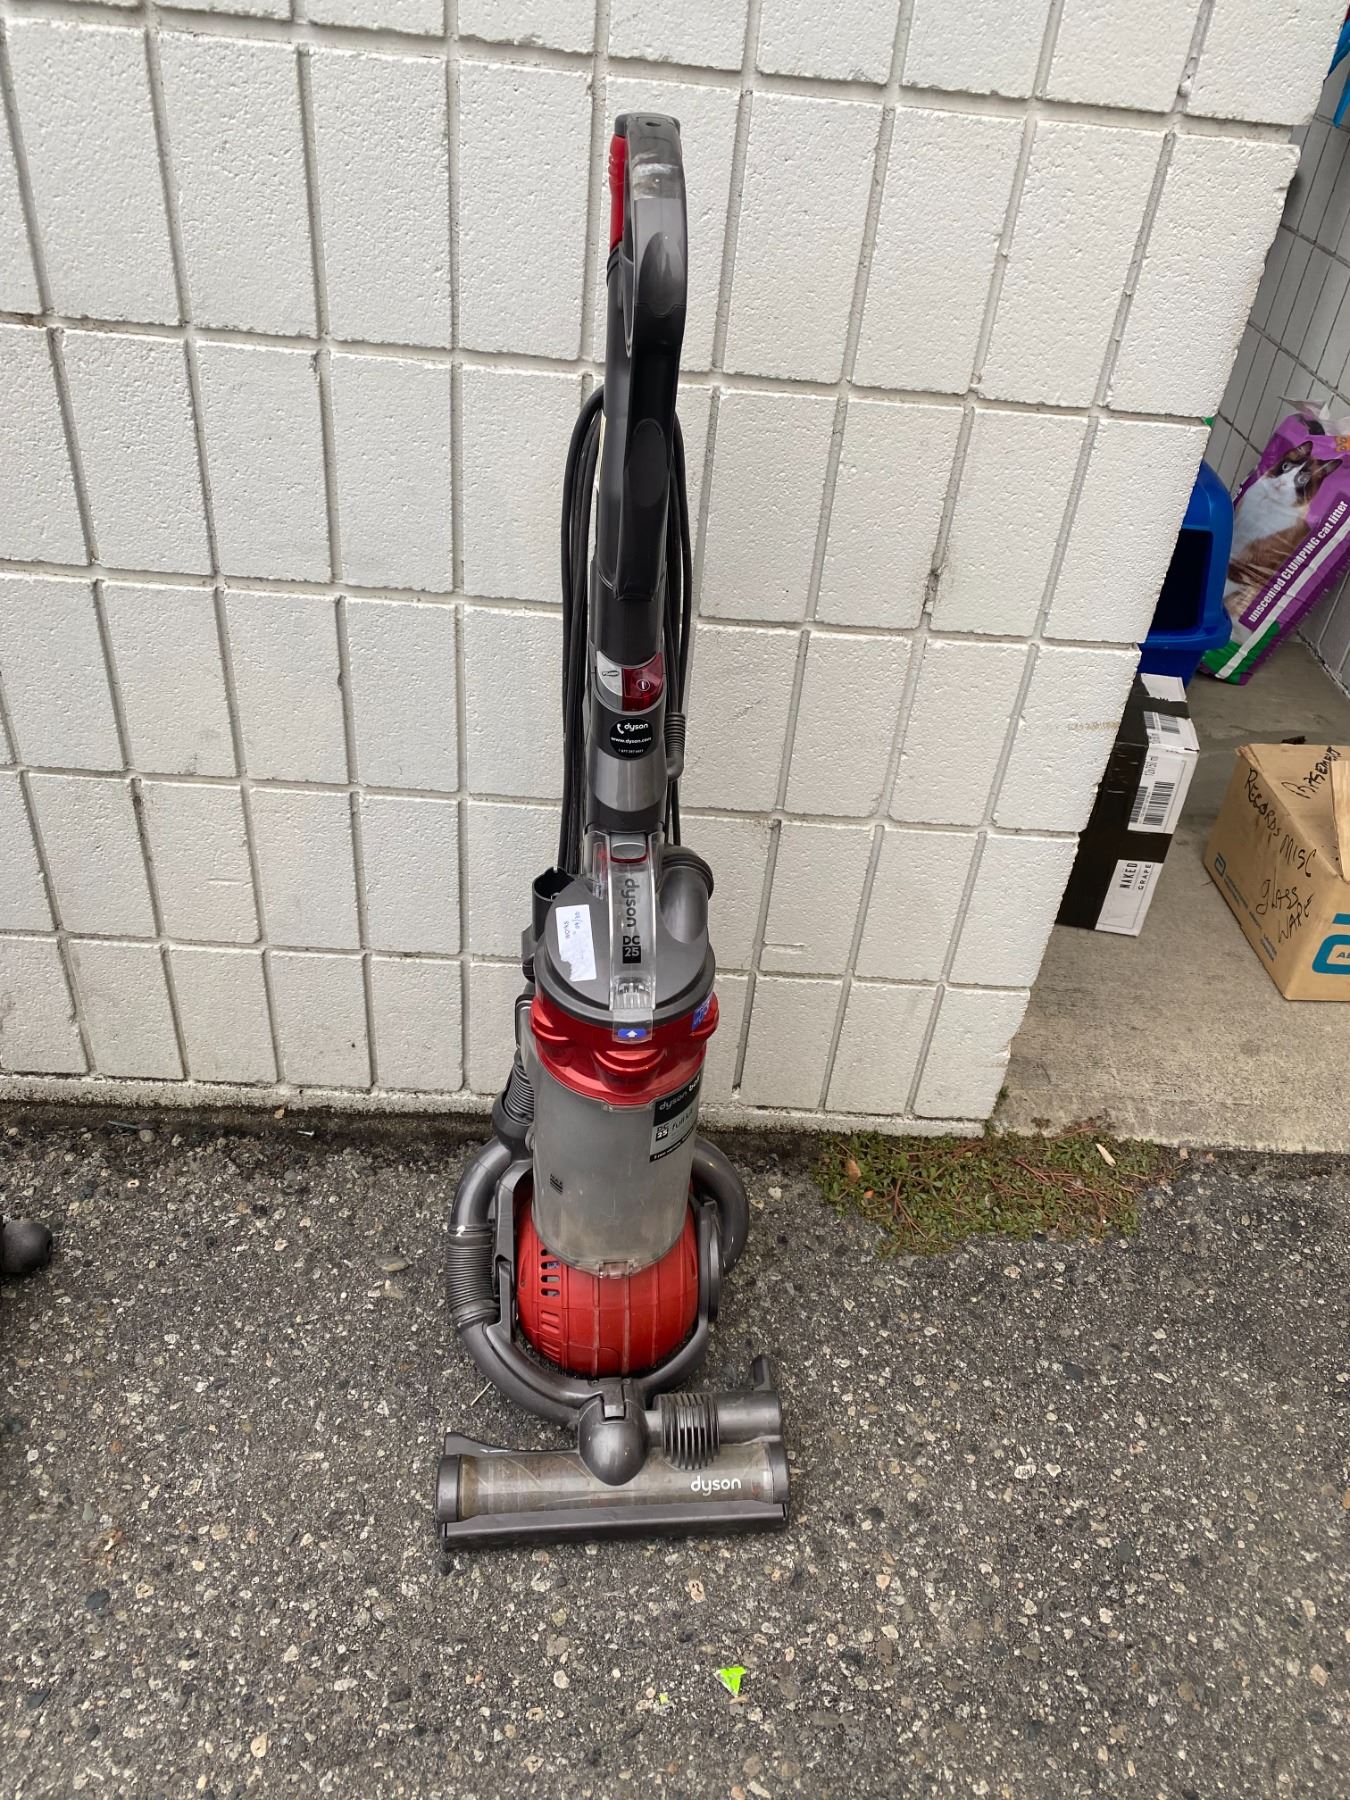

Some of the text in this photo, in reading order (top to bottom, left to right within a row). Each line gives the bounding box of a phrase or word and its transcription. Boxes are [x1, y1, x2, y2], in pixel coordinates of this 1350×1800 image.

[1248, 578, 1286, 622] unscented
[1281, 536, 1321, 580] CLUMPING
[1317, 520, 1333, 539] cat
[1327, 500, 1349, 526] litter
[624, 722, 649, 732] dyson
[1280, 834, 1317, 878] MISC
[1120, 862, 1138, 889] NAKED
[1138, 864, 1152, 890] GRAPE
[621, 878, 640, 928] dyson
[623, 935, 640, 945] DC
[624, 947, 640, 957] 25
[659, 1091, 687, 1110] dyson
[690, 1474, 742, 1497] dyson
